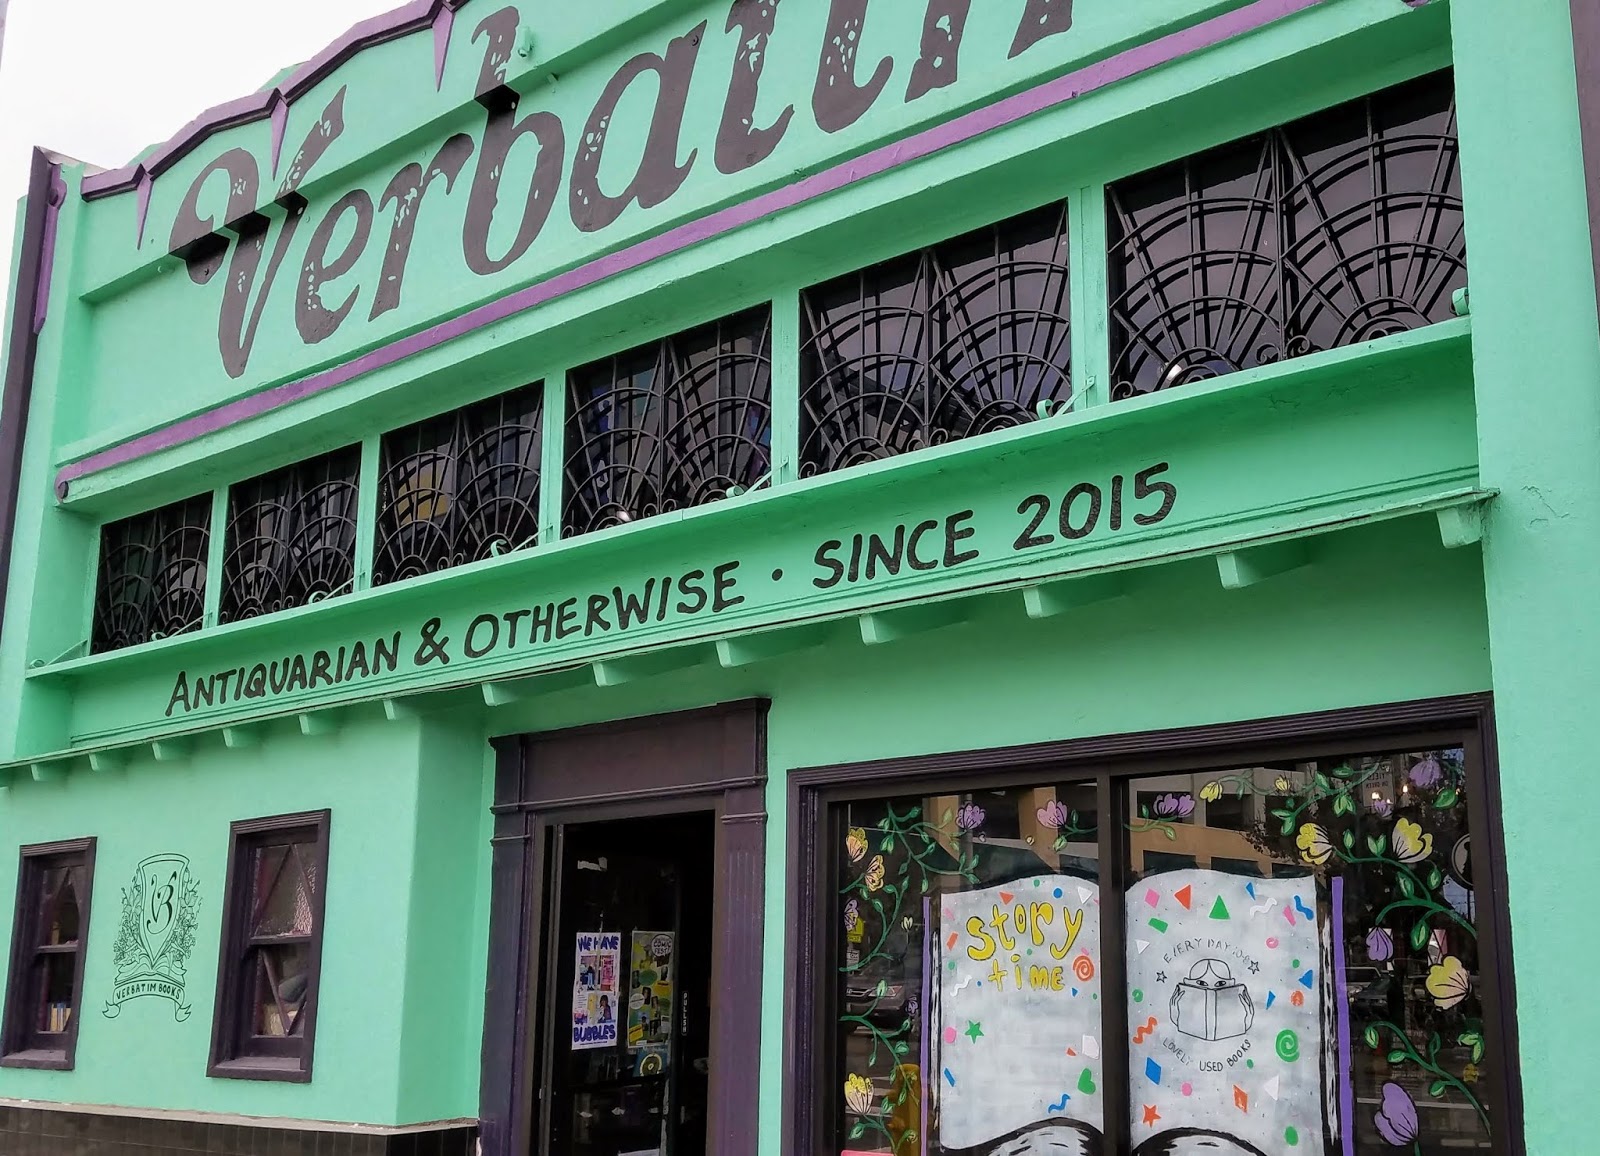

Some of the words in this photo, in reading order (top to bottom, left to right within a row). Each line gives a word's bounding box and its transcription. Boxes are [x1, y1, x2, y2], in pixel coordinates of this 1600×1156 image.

[164, 630, 402, 717] ANTIQUARIAN
[413, 616, 451, 666] &
[463, 559, 746, 659] OTHERWISE
[812, 508, 980, 589] SINCE
[1012, 461, 1178, 551] 2015
[577, 935, 592, 952] WE
[116, 982, 157, 1000] VERBATIM
[158, 983, 181, 1000] BOOKS
[573, 1024, 616, 1043] BUBBLES
[1199, 1060, 1223, 1072] USED
[1226, 1038, 1252, 1068] BOOKS
